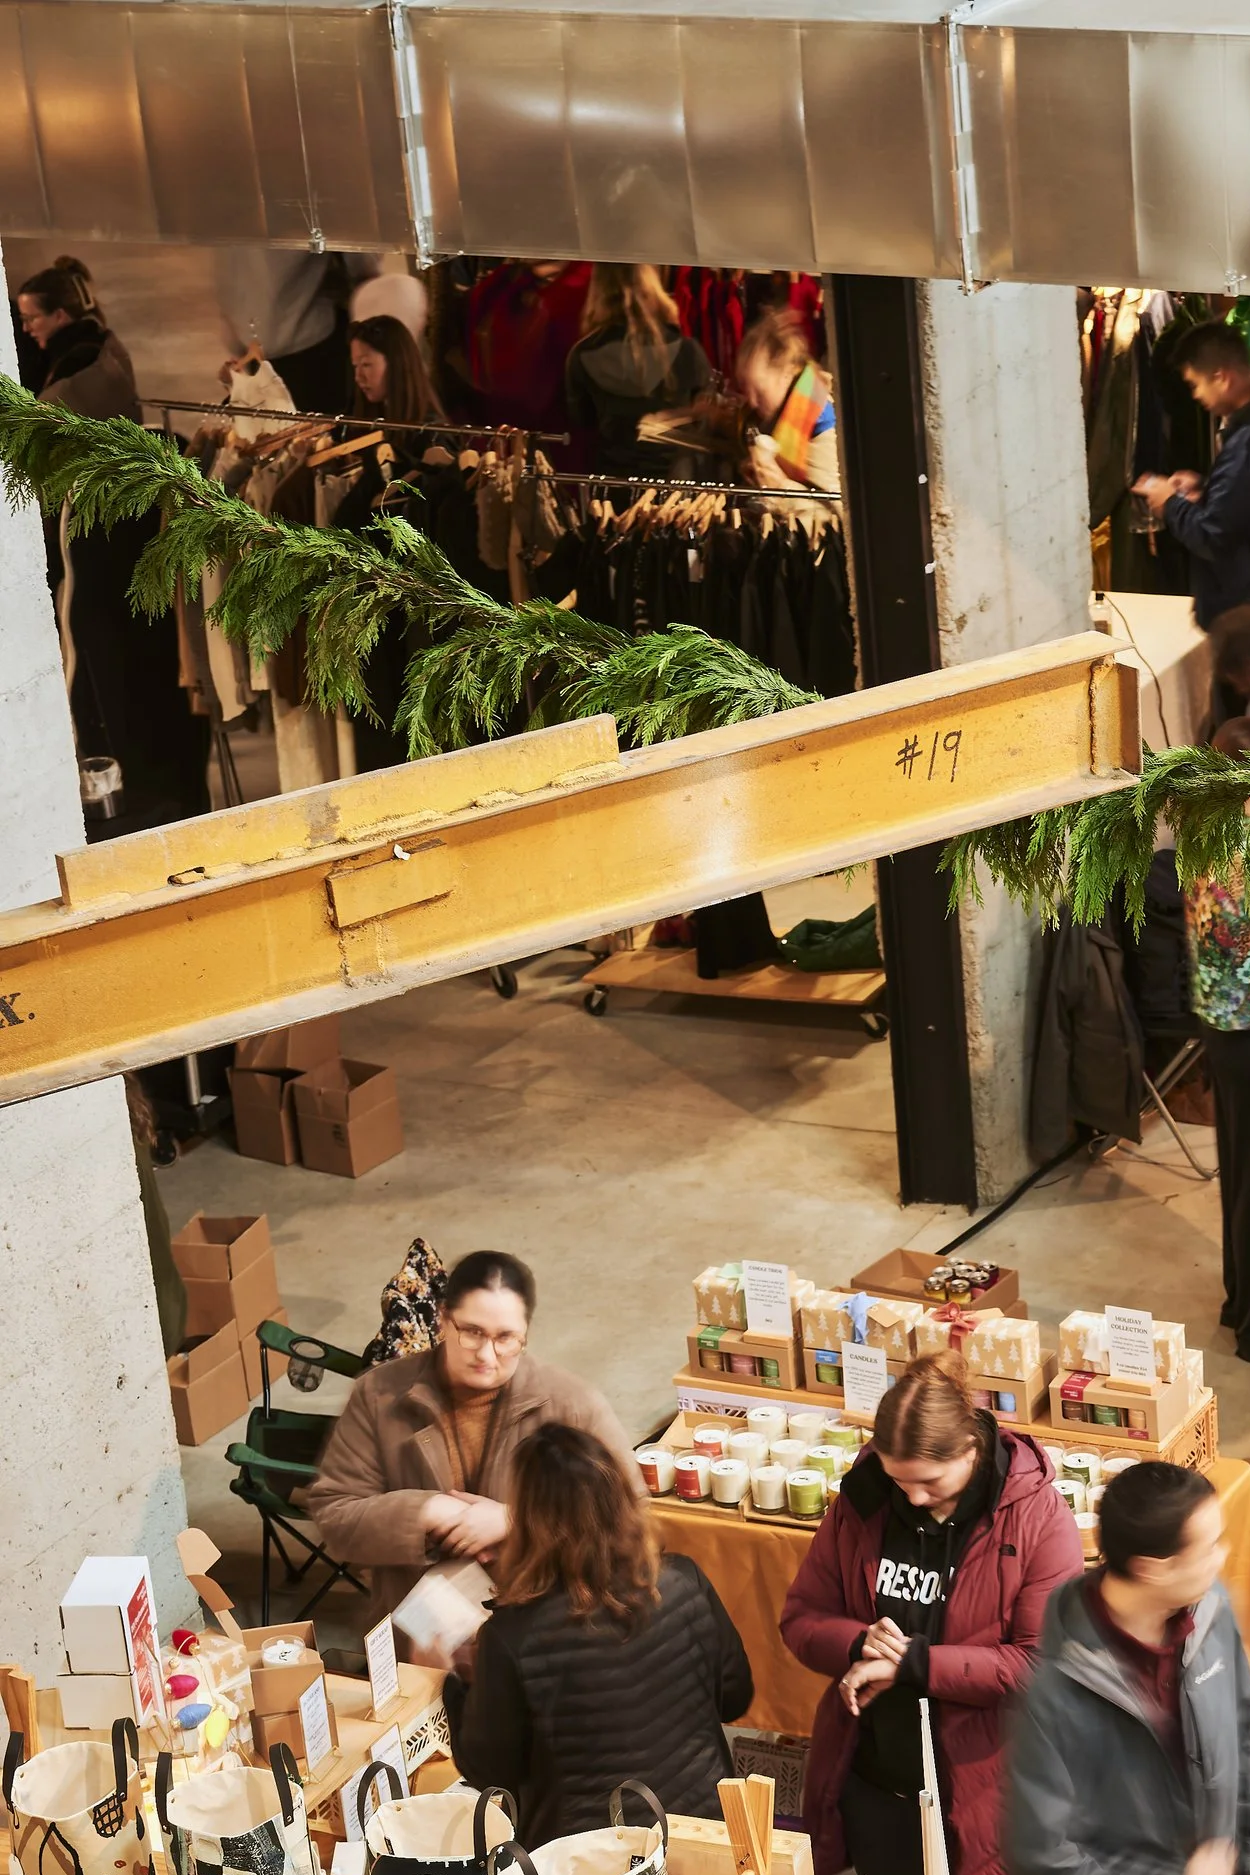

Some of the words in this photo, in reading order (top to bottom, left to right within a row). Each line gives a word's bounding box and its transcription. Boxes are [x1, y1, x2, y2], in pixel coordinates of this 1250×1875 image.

[895, 729, 962, 783] #19
[1114, 1315, 1142, 1325] HOLIDAY
[1110, 1323, 1148, 1335] COLLECTION
[849, 1353, 878, 1364] CANDLES
[875, 1557, 955, 1605] RESO
